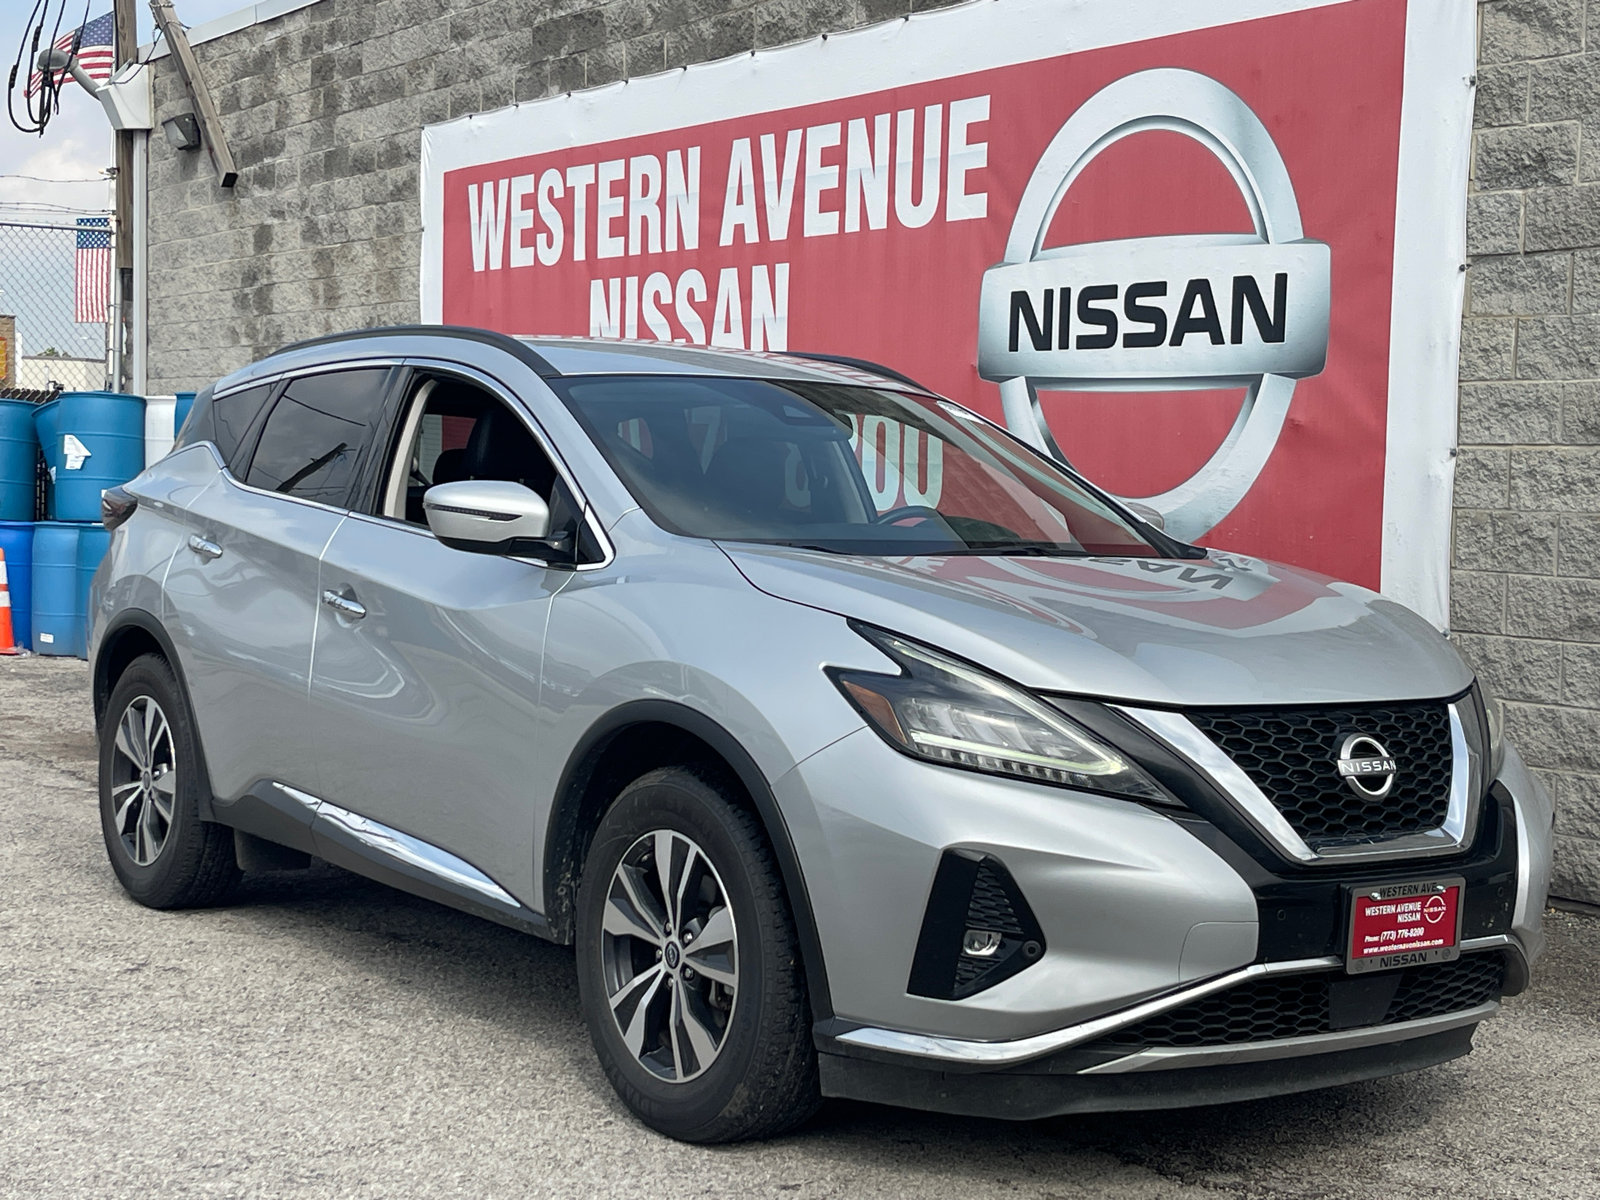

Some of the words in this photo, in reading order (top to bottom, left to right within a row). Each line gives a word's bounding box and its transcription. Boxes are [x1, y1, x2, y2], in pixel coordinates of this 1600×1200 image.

[467, 145, 701, 273] WESTERN
[718, 94, 991, 248] AVENUE
[589, 262, 790, 353] NISSAN
[1008, 273, 1288, 352] NISSAN
[1340, 760, 1396, 772] NISSAN
[1379, 884, 1418, 898] WESTERN
[1365, 904, 1396, 916] WESTERN
[1396, 901, 1421, 913] AVENUE
[1397, 912, 1421, 923] NISSAN
[1380, 930, 1396, 943] (773)
[1397, 927, 1424, 939] 776-8200
[1363, 939, 1443, 954] www.westernavenissan.com
[1380, 953, 1427, 968] NISSAN
